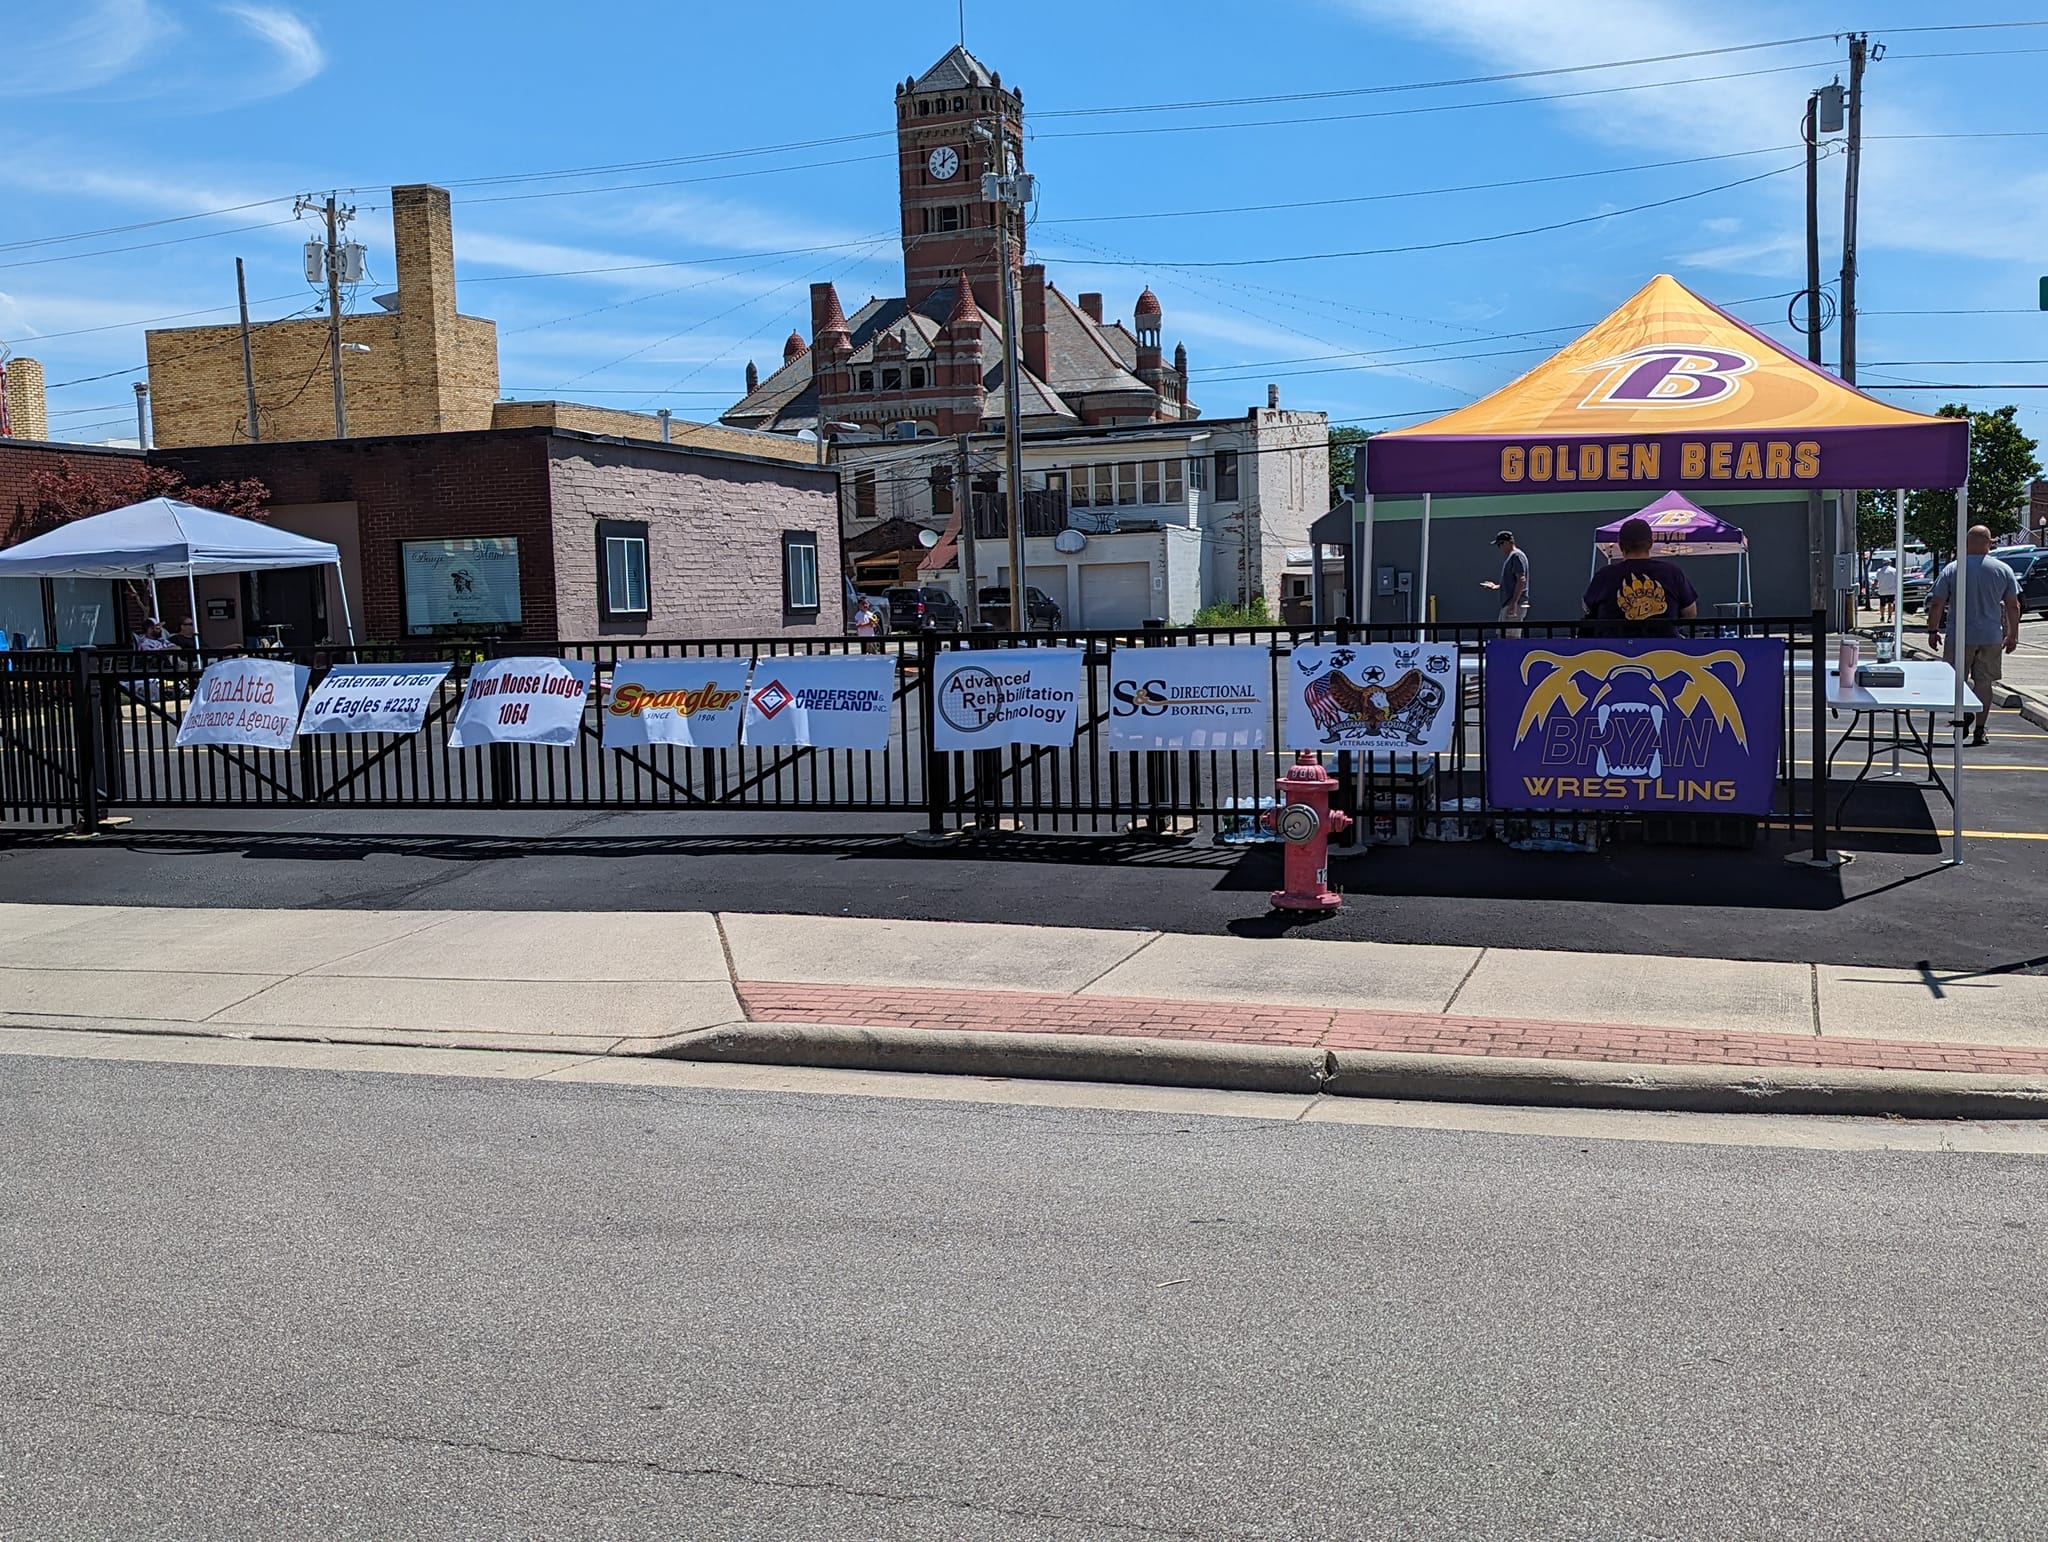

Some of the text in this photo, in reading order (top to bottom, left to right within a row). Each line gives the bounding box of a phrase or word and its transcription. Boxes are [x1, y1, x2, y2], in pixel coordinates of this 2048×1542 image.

[1501, 441, 1821, 482] GOLDEN BEARS
[207, 674, 274, 704] VanAtta
[324, 674, 436, 689] Fraternal Order
[468, 673, 584, 700] Bryan Moose Lodge
[950, 670, 1030, 693] Advanced
[1171, 685, 1255, 699] DIRECTIONAL
[609, 681, 741, 717] Spangler
[795, 689, 878, 701] ANDERSON
[795, 700, 872, 711] VREELAND
[963, 687, 1074, 709] Rehabilitation
[1113, 680, 1168, 717] S&S
[315, 696, 420, 718] of Eagles #2233
[498, 703, 529, 725] 1064
[646, 712, 671, 720] SINCE
[974, 704, 1066, 725] Technology
[1171, 705, 1228, 716] BORING,
[185, 708, 289, 736] Insurance Agency
[1331, 720, 1415, 732] WILLIAMS COUNTY
[1542, 716, 1713, 767] BRYAN
[1523, 777, 1736, 802] WRESTLING
